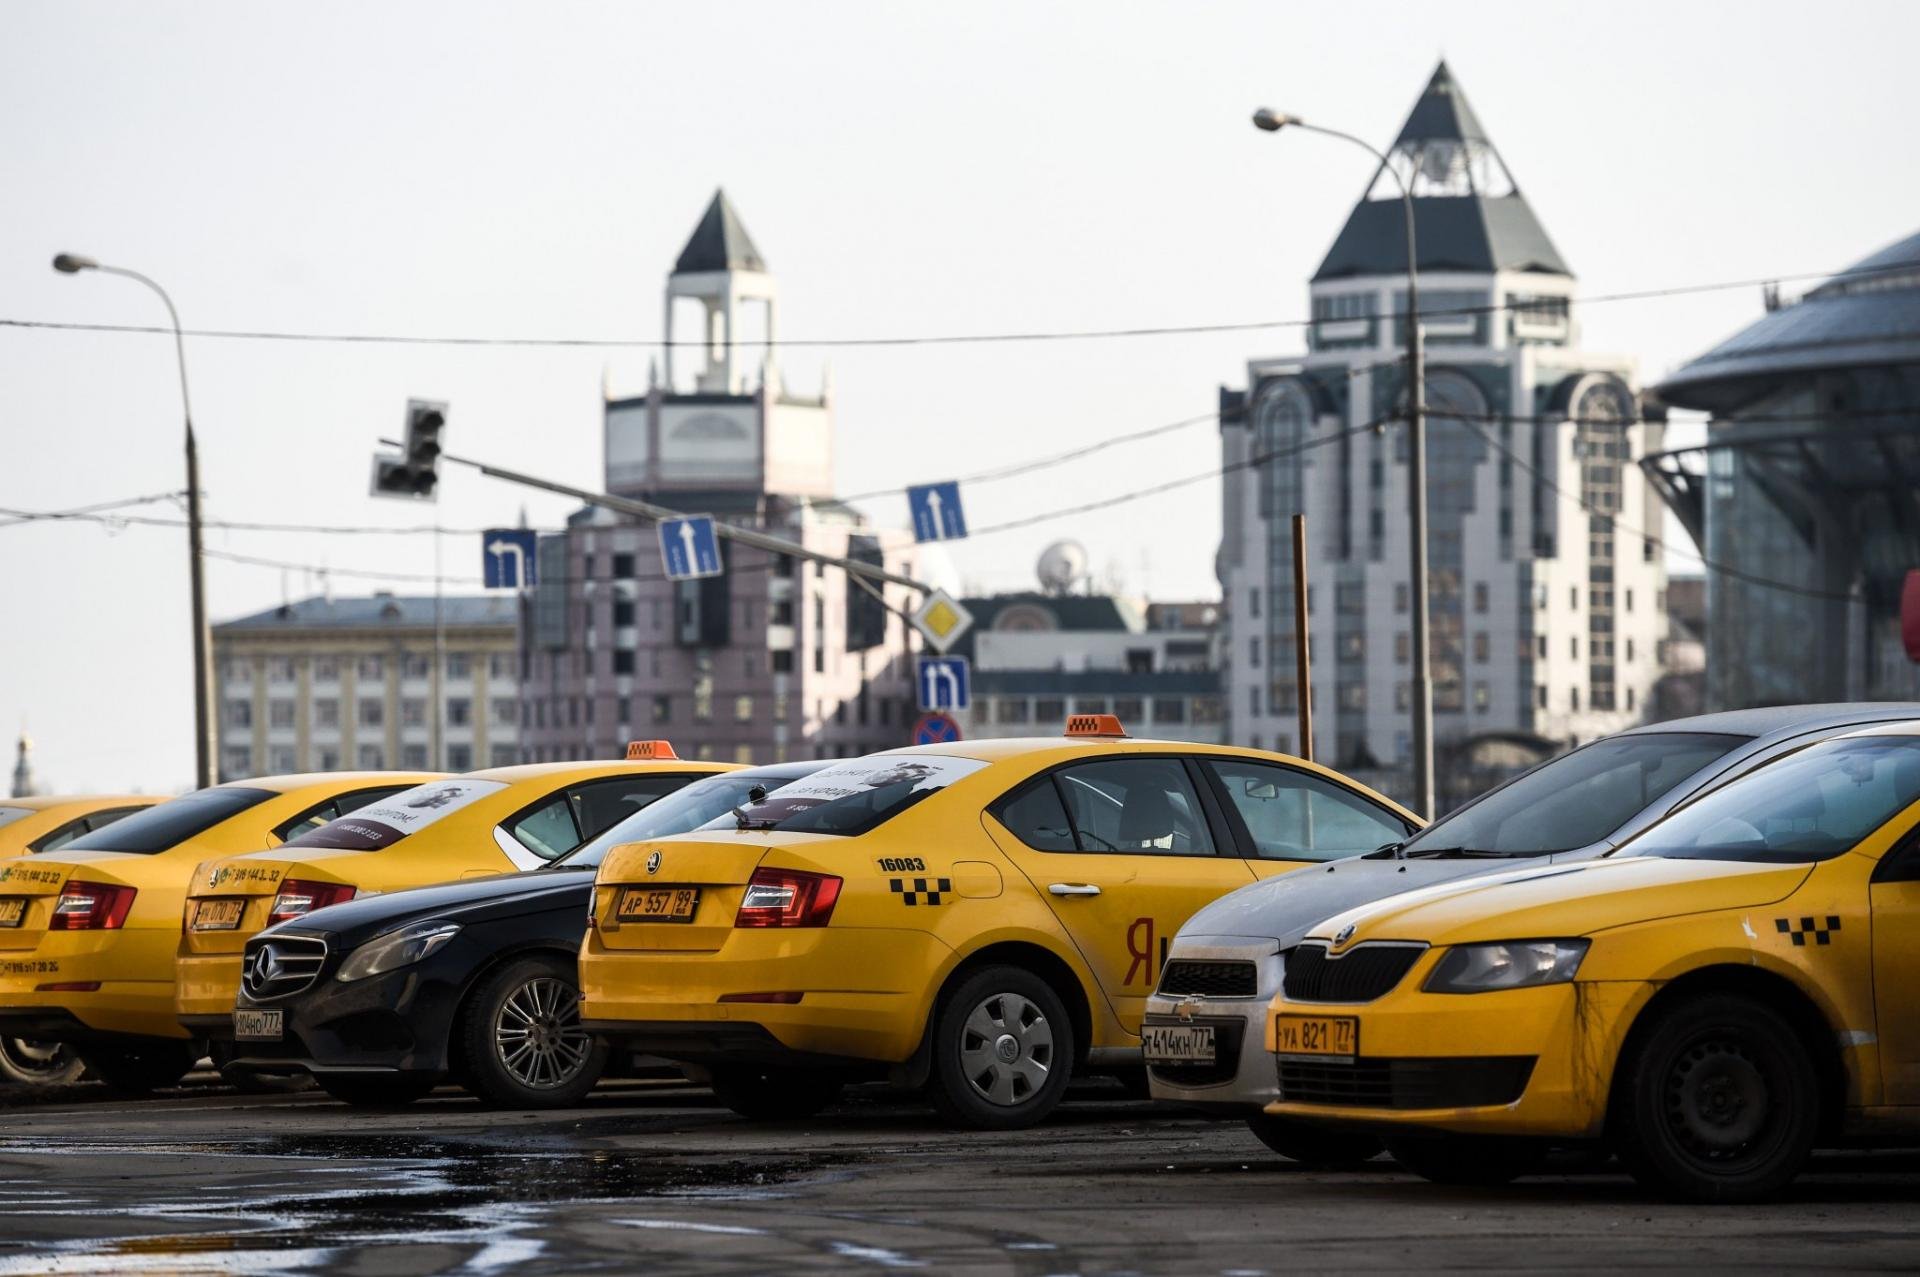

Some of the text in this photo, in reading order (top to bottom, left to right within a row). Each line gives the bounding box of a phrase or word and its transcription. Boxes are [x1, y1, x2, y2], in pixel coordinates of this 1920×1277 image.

[877, 857, 926, 872] 16083
[645, 892, 672, 914] 557
[677, 891, 692, 907] 99
[262, 1012, 280, 1028] 777
[1192, 1028, 1211, 1048] 777
[1302, 1022, 1327, 1050] 821
[1335, 1020, 1351, 1042] 77
